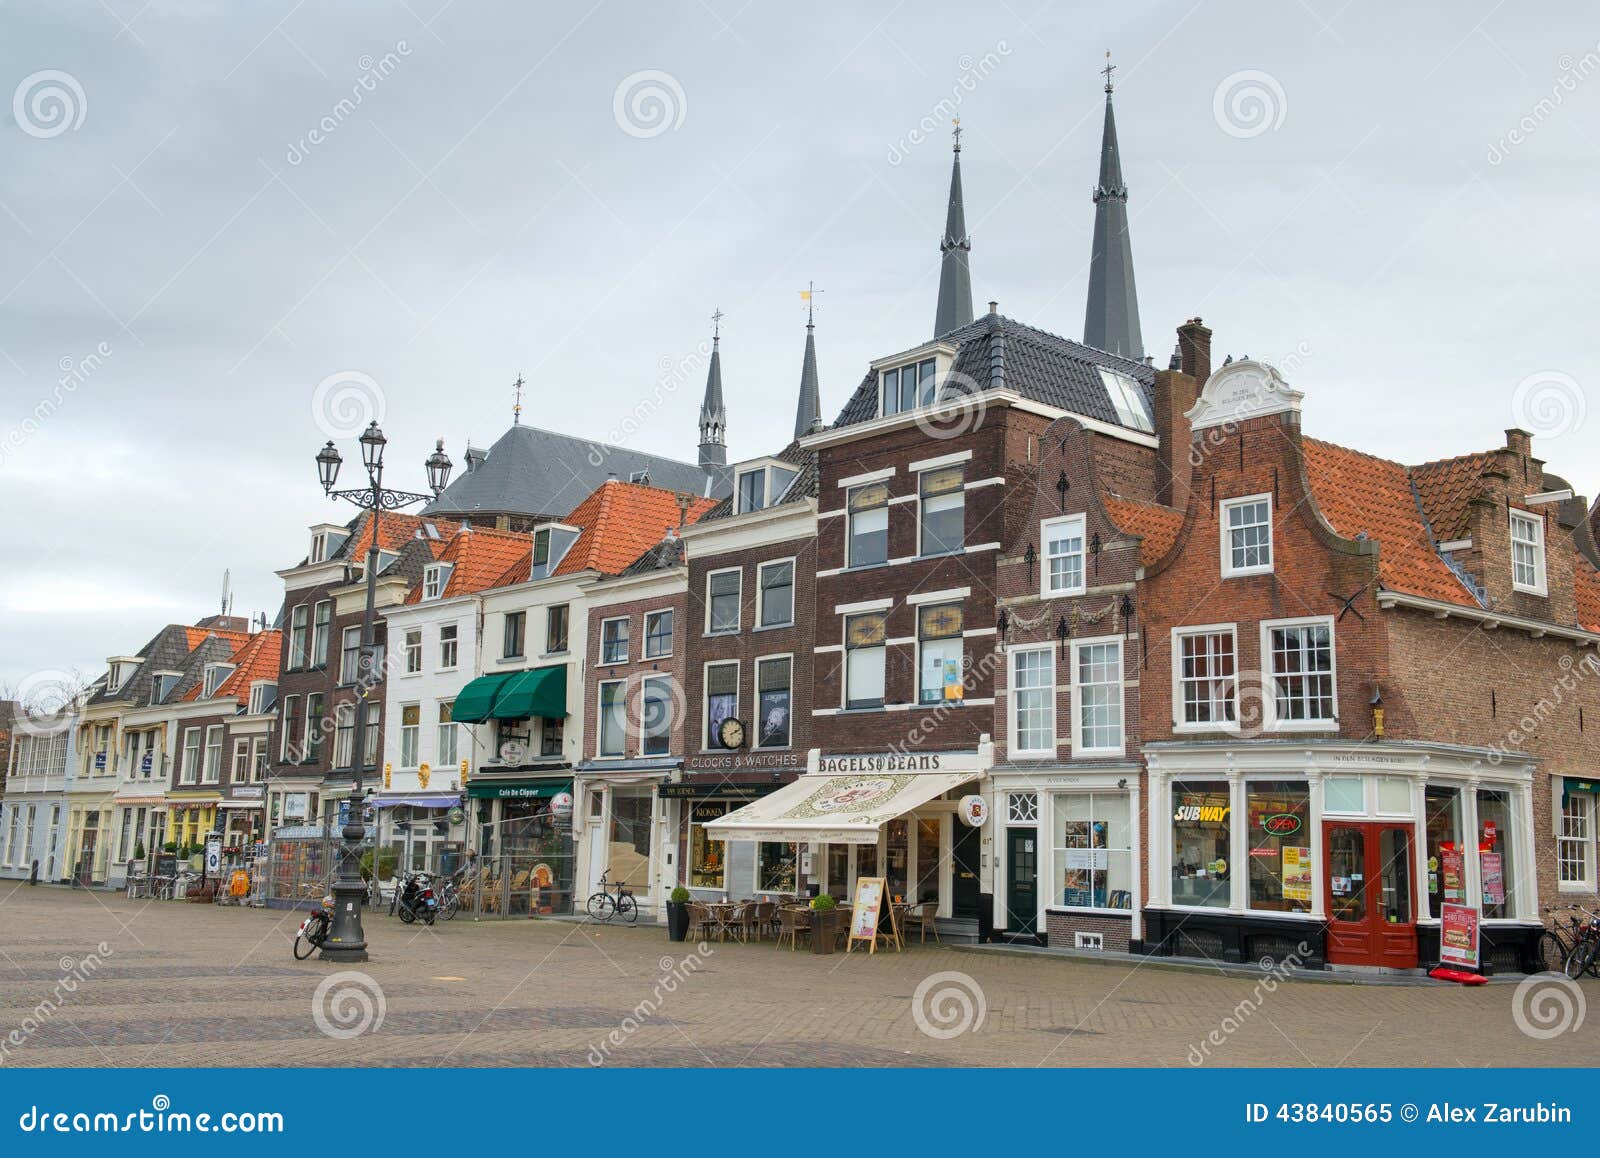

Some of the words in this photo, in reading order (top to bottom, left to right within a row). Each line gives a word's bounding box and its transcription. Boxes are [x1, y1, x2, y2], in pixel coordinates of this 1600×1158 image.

[691, 757, 732, 768] CLOCKS
[734, 757, 742, 767] &
[745, 754, 798, 767] WATCHES
[818, 757, 875, 773] BAGELS
[887, 754, 940, 771] BEANS
[519, 788, 539, 798] Clipper
[1174, 805, 1231, 821] SUBWAY
[1268, 818, 1297, 831] OPEN
